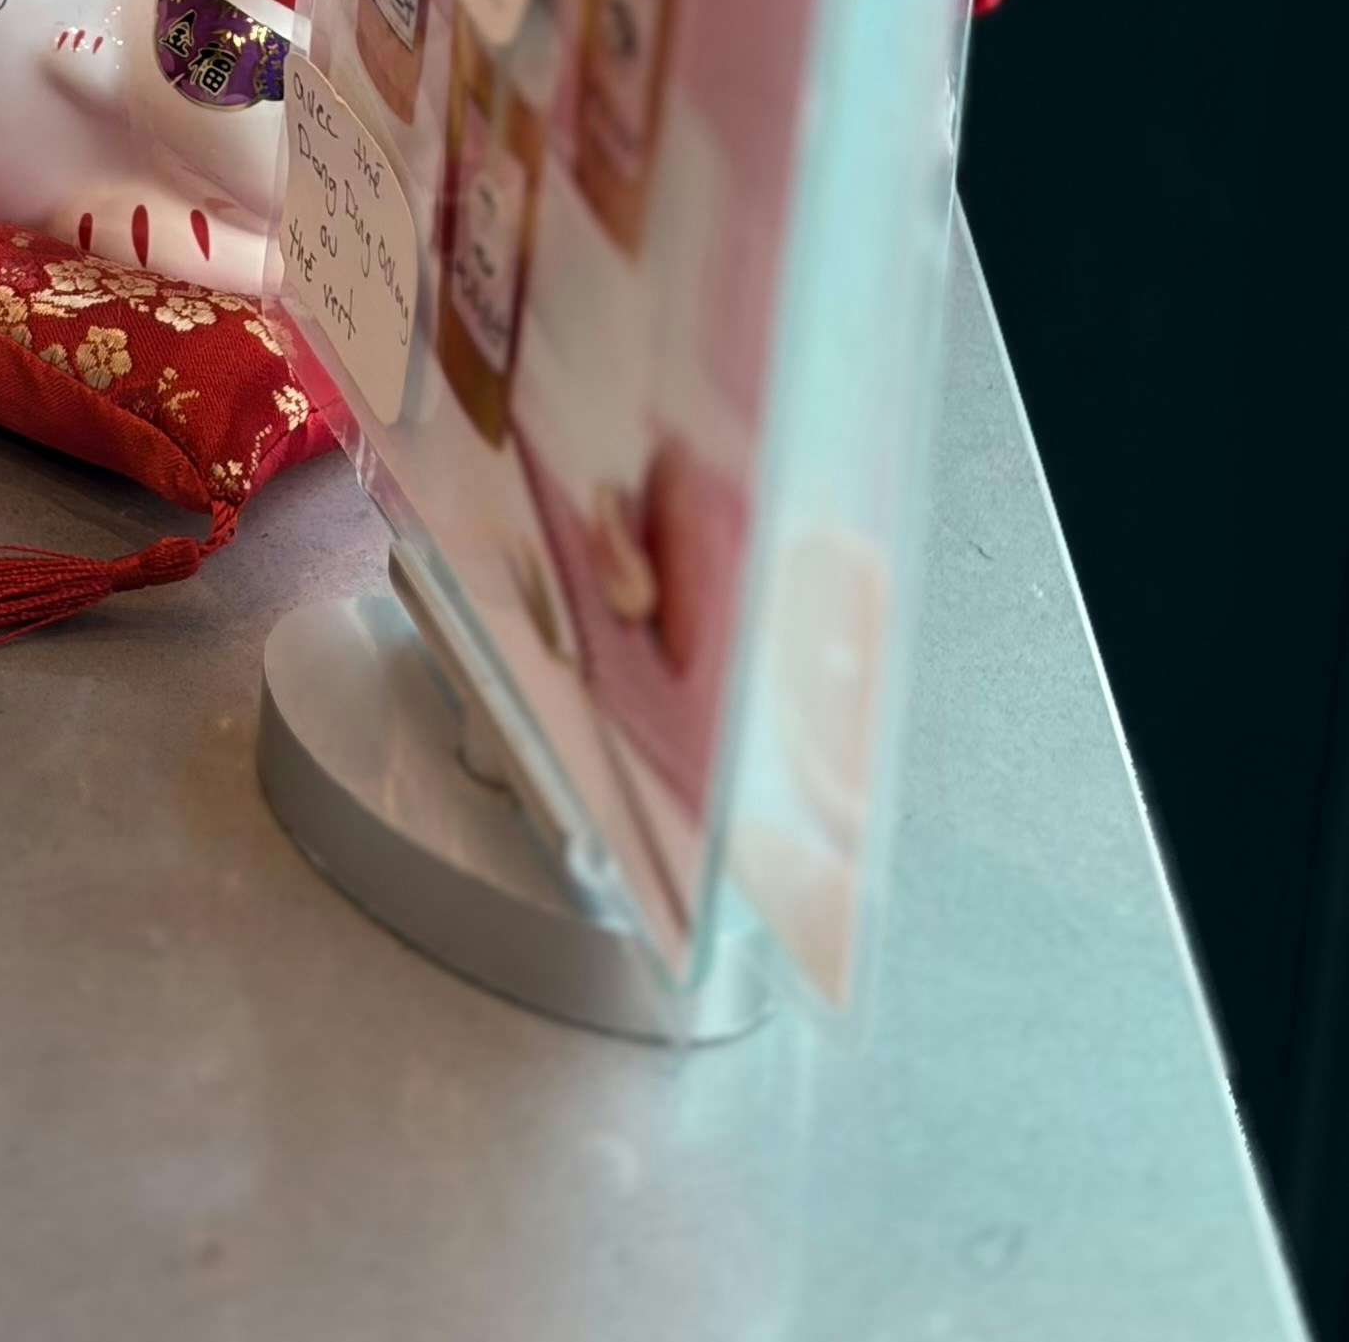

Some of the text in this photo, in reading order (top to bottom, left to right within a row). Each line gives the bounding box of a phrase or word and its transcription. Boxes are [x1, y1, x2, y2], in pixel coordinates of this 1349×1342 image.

[293, 72, 338, 139] avec
[297, 122, 337, 217] Dong
[320, 225, 337, 258] ou
[323, 283, 356, 340] vert
